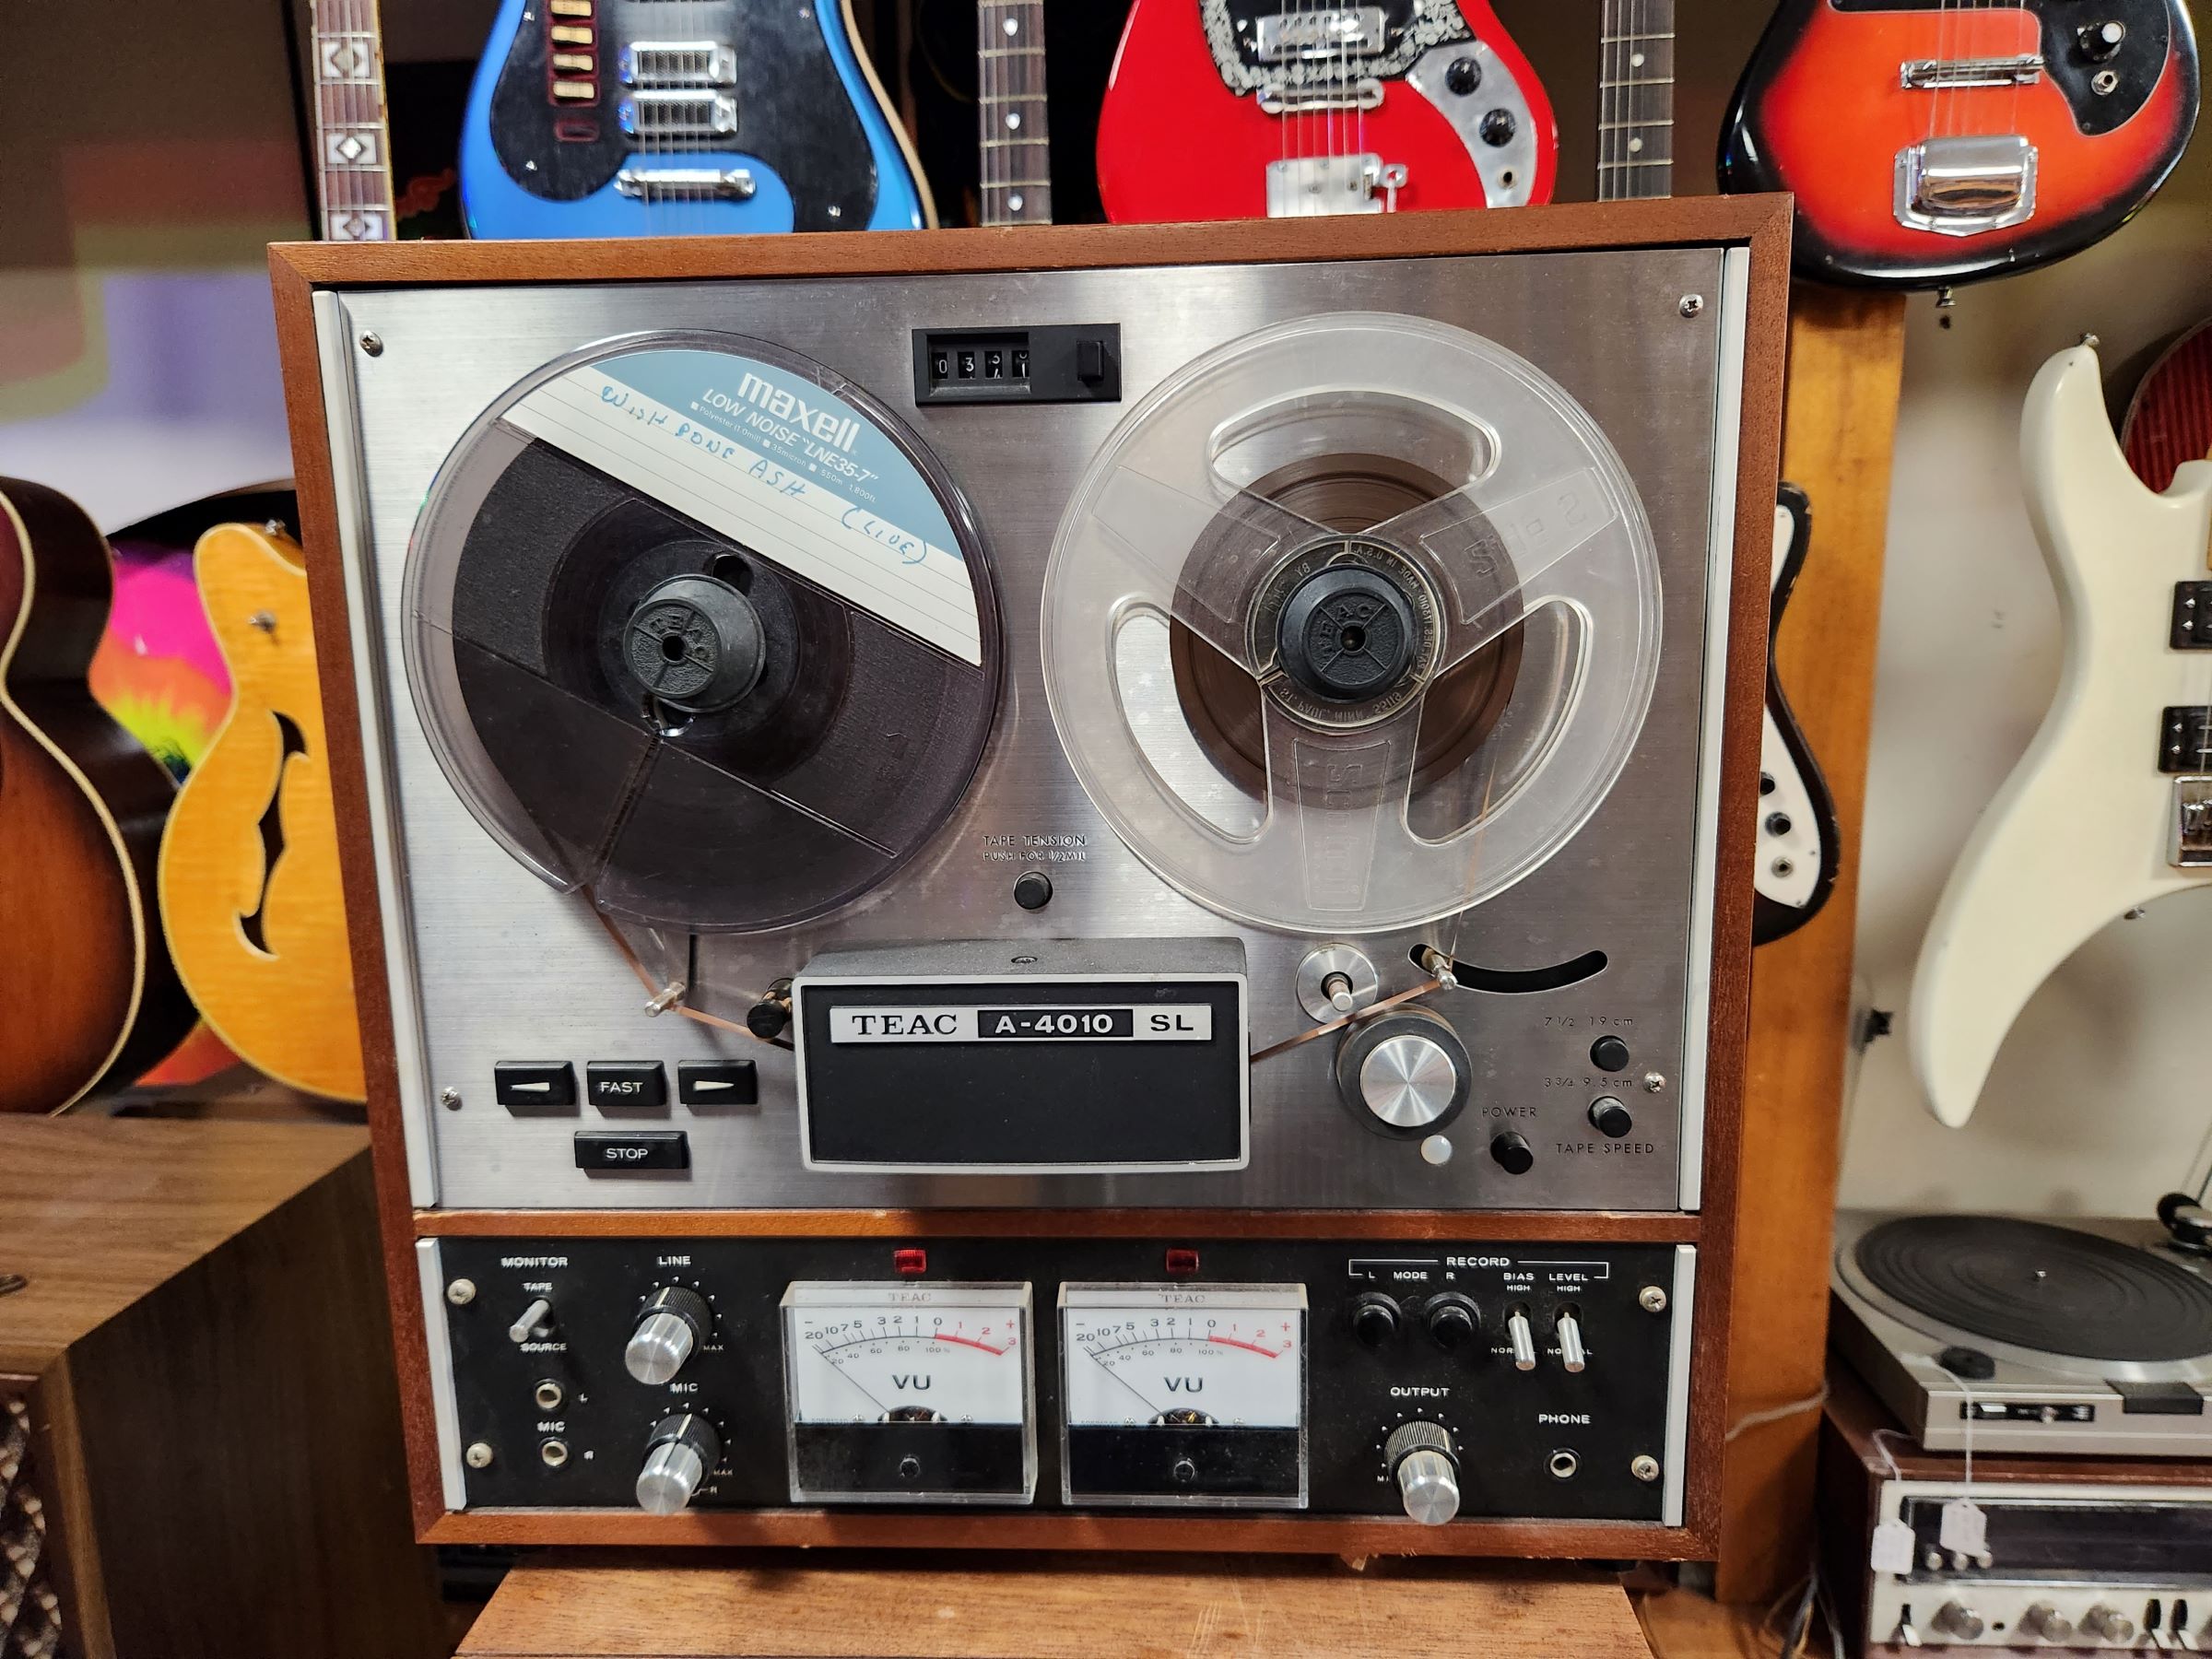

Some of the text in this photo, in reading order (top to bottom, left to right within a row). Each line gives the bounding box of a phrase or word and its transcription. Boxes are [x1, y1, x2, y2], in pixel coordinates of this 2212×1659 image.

[700, 406, 735, 430] Polyester
[702, 388, 745, 418] LOW
[745, 411, 801, 448] NOISE
[737, 372, 861, 453] maxell
[748, 459, 806, 496] ASH
[982, 834, 1087, 847] TAPE TENSION
[982, 851, 1015, 863] PUSH
[1019, 851, 1044, 862] FOR
[852, 1014, 1194, 1035] TEAC A-4010 SL
[600, 1081, 643, 1094] FAST
[1482, 1107, 1536, 1117] POWER
[606, 1148, 648, 1159] STOP
[1556, 1143, 1654, 1153] TAPE SPEED
[500, 1256, 569, 1267] MONITOR
[657, 1255, 691, 1266] LINE
[1446, 1256, 1511, 1267] RECORD
[1393, 1271, 1428, 1280] MODE
[1503, 1272, 1589, 1281] BIAS LEVEL
[522, 1282, 553, 1292] TAPE
[1506, 1284, 1531, 1292] HIGH
[805, 1330, 824, 1340] 20
[825, 1324, 839, 1335] 10
[853, 1320, 863, 1329] 5
[877, 1316, 887, 1325] 3
[893, 1315, 903, 1324] 2
[933, 1316, 943, 1326] 0
[1076, 1333, 1095, 1342] 20
[1097, 1326, 1111, 1336] 10
[1125, 1322, 1135, 1331] 5
[1150, 1318, 1159, 1327] 3
[1166, 1317, 1175, 1326] 2
[1206, 1319, 1217, 1328] 0
[520, 1343, 568, 1352] SOURCE
[670, 1383, 699, 1393] MIC
[892, 1375, 931, 1390] VU
[1164, 1377, 1204, 1393] VU
[1390, 1386, 1451, 1397] OUTPUT
[1538, 1414, 1591, 1424] PHONE
[537, 1422, 565, 1432] MIC
